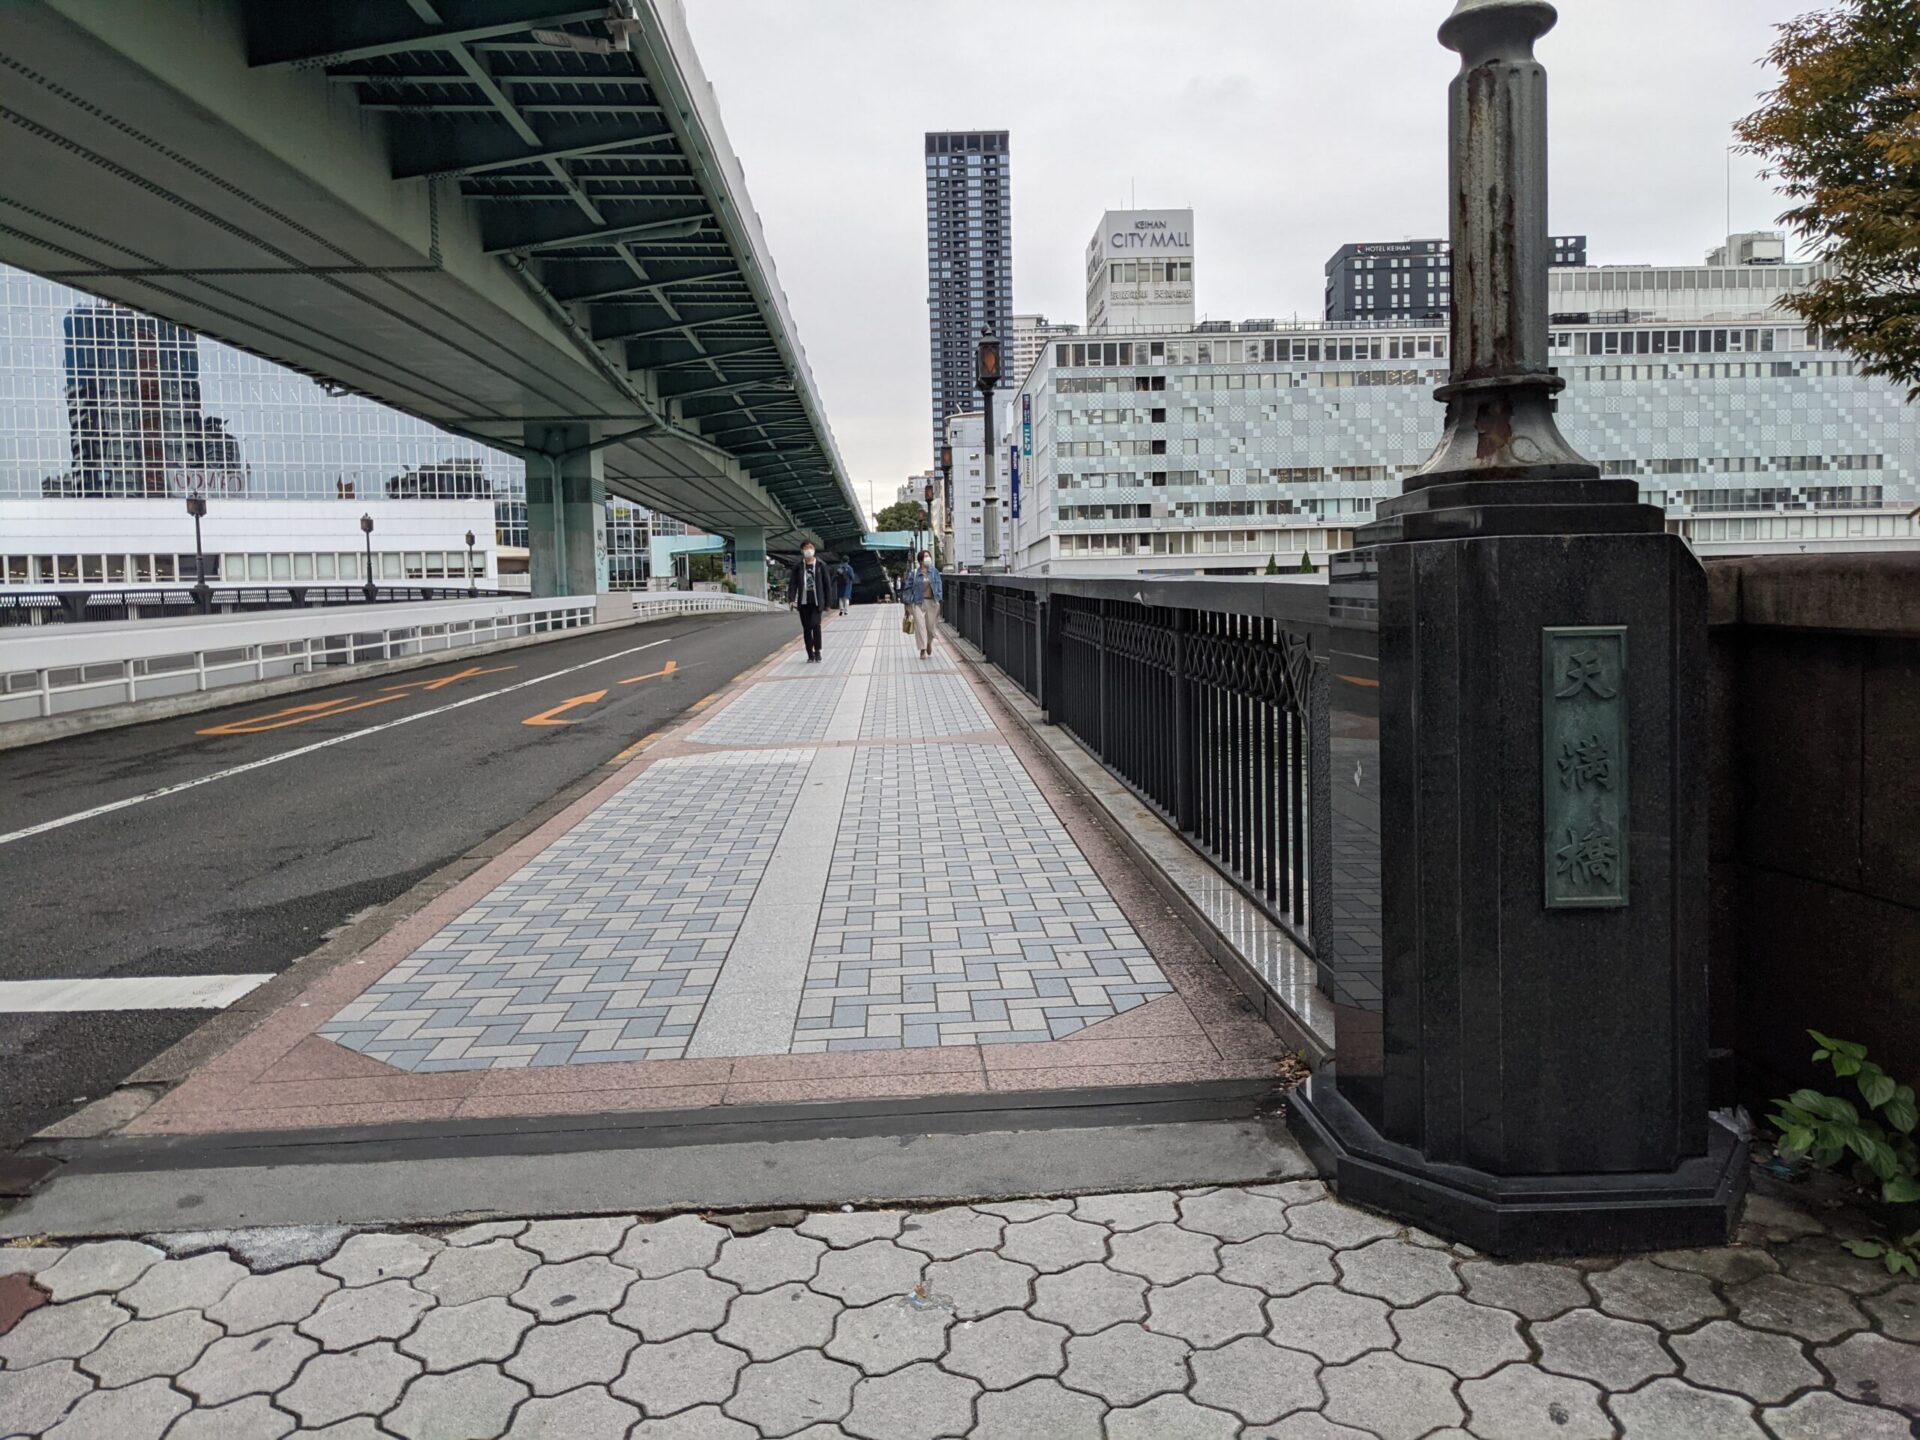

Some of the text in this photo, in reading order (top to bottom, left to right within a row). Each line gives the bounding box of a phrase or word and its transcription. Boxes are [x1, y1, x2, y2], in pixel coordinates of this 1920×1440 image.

[1134, 220, 1167, 229] KEIHAN
[1111, 231, 1190, 248] CITY MALL
[1365, 244, 1411, 253] HOTEL KEIHAN
[1555, 648, 1618, 886] 天満橋
